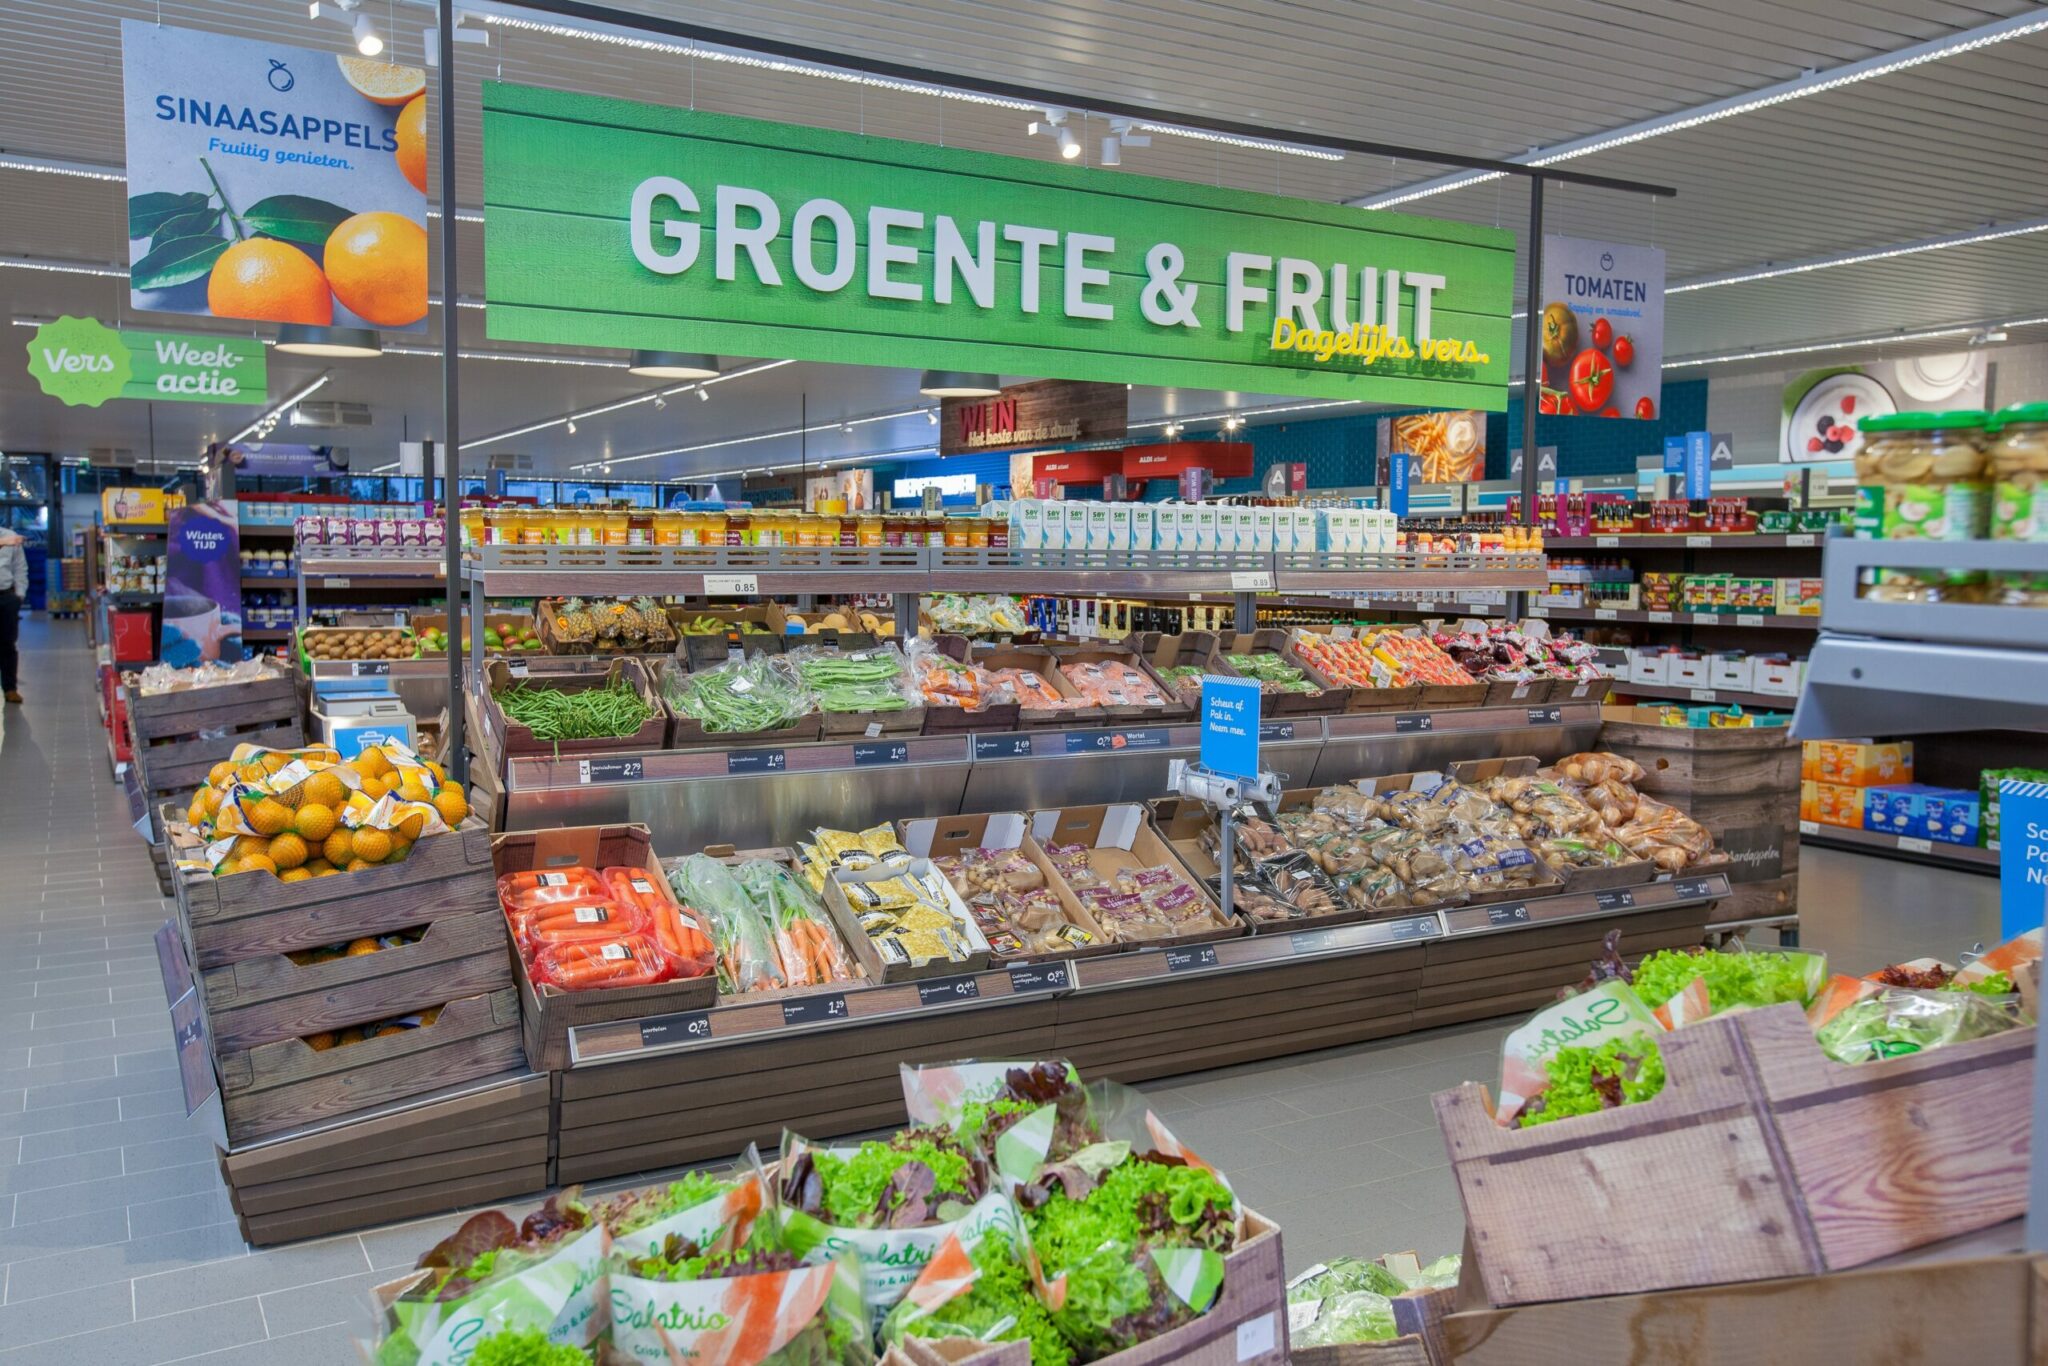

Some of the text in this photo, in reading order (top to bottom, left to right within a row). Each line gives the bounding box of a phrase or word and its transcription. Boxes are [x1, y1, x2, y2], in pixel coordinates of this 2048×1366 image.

[155, 95, 399, 153] SINAASAPPELS
[209, 137, 355, 171] Fruitig genieten.
[630, 176, 1446, 347] GROENTE & FRUIT
[1565, 274, 1646, 302] TOMATEN
[1271, 316, 1490, 366] Dagelijks vers.
[42, 348, 115, 375] Vers
[155, 340, 243, 370] Week-
[156, 367, 241, 397] actie
[960, 399, 1017, 443] WIJN
[968, 431, 985, 447] Het
[986, 428, 1012, 445] beste
[1013, 429, 1033, 442] van
[1034, 422, 1049, 439] de
[1537, 453, 1556, 471] A
[1711, 441, 1732, 461] A
[186, 530, 224, 541] Winter
[193, 541, 217, 549] TIJD
[735, 584, 755, 592] 0.85
[1253, 578, 1268, 587] 0.89
[1209, 723, 1228, 733] Neem
[1210, 710, 1234, 721] Pak in.
[956, 980, 975, 994] 0.49
[610, 1288, 734, 1331] Salatrio
